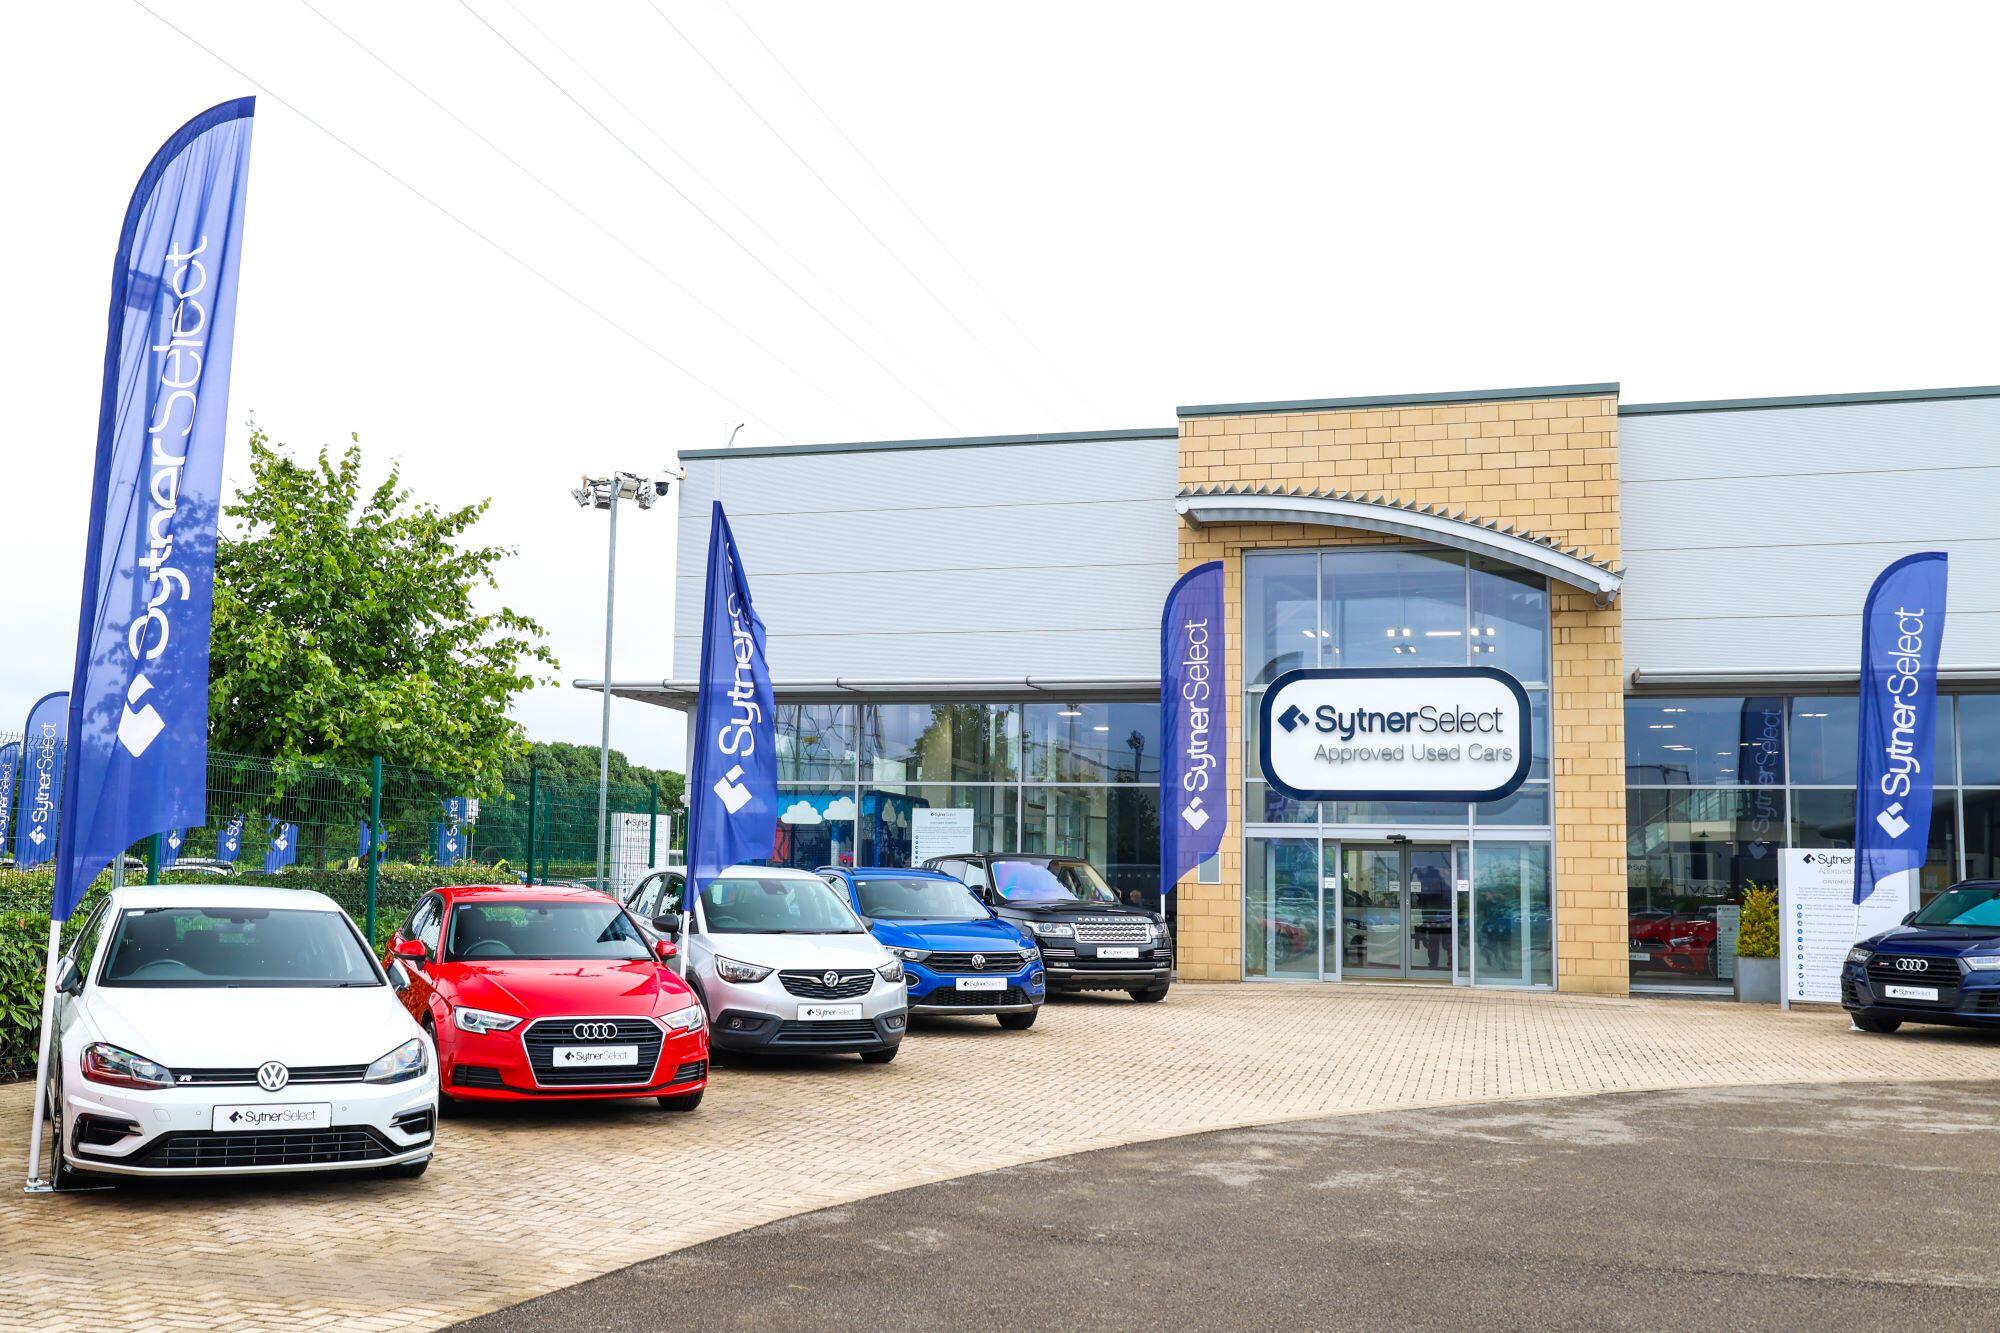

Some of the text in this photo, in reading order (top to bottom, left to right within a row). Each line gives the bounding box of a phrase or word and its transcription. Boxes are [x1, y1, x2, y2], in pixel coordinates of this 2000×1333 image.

[1183, 618, 1216, 792] SytnerSelect
[1881, 606, 1925, 798] SytnerSelect
[1315, 704, 1504, 741] SytnerSelect
[1314, 743, 1513, 764] Approved Used Cars
[32, 722, 57, 823] SytnerSelect
[1751, 708, 1782, 834] SytnerSelect
[970, 980, 1001, 988] SytnerSelect
[815, 1008, 854, 1017] SytnerSelect
[576, 1050, 628, 1063] SytnerSelect
[245, 1109, 317, 1125] SytnerSelect
